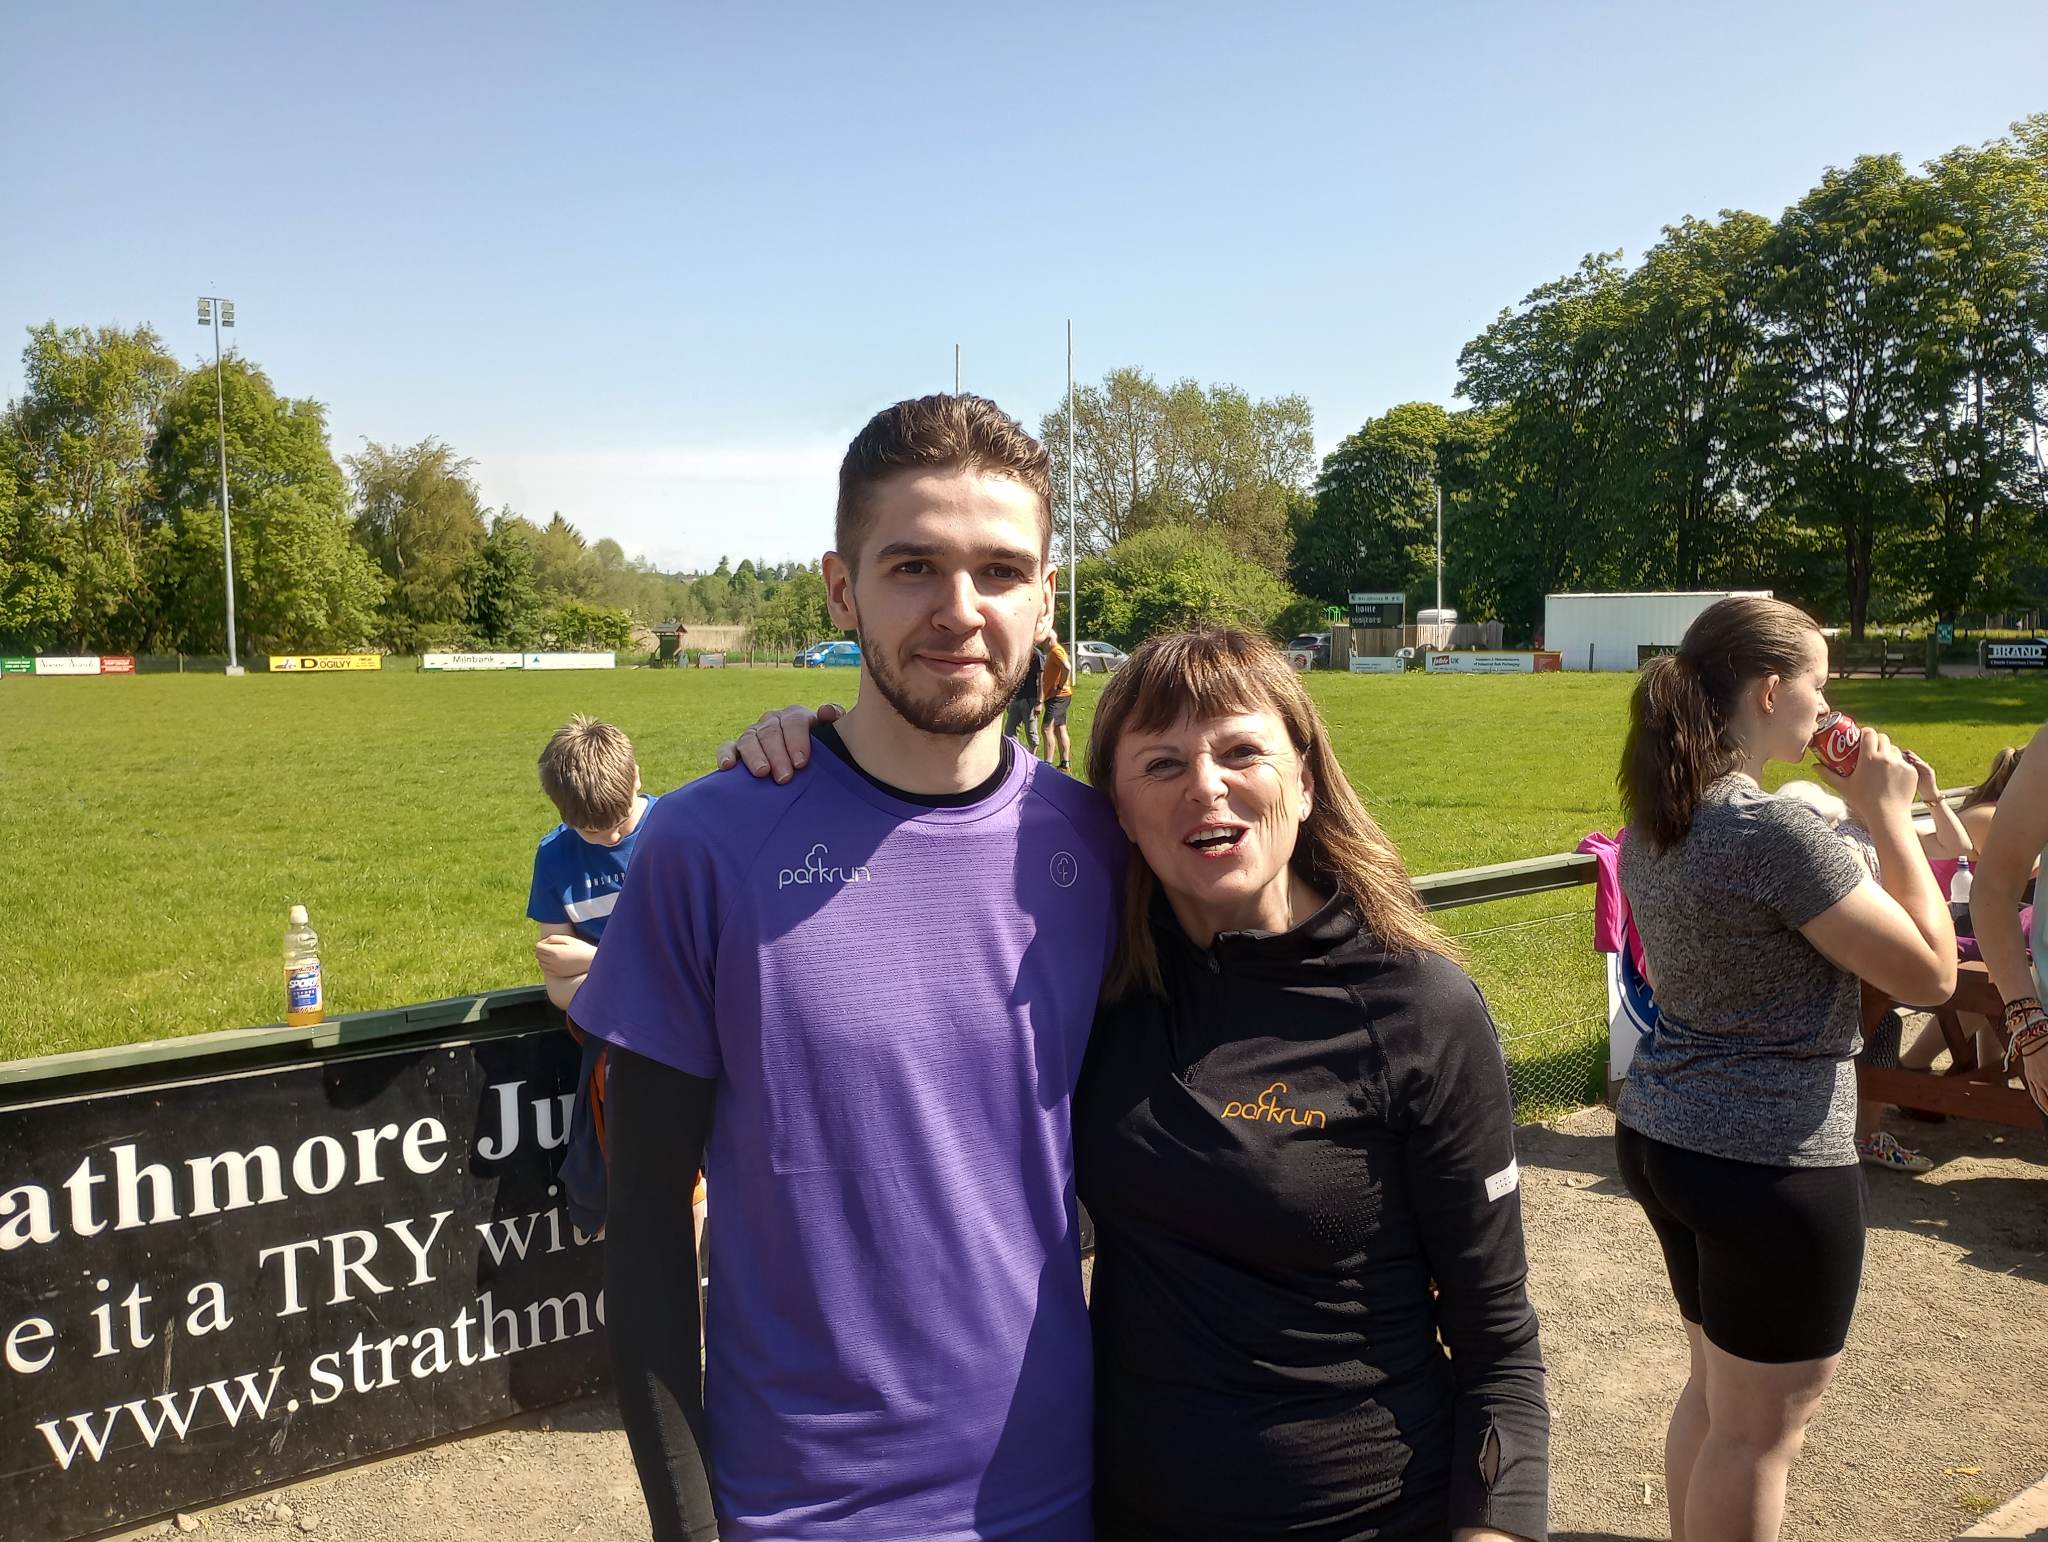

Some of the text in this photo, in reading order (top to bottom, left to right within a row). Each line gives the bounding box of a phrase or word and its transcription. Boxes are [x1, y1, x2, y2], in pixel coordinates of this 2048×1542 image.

[1992, 645, 2043, 658] BRAND
[778, 844, 871, 889] parkrun
[1220, 1082, 1327, 1128] parkrun
[0, 1115, 449, 1250] athmore
[6, 1184, 606, 1374] e it a TRY wi
